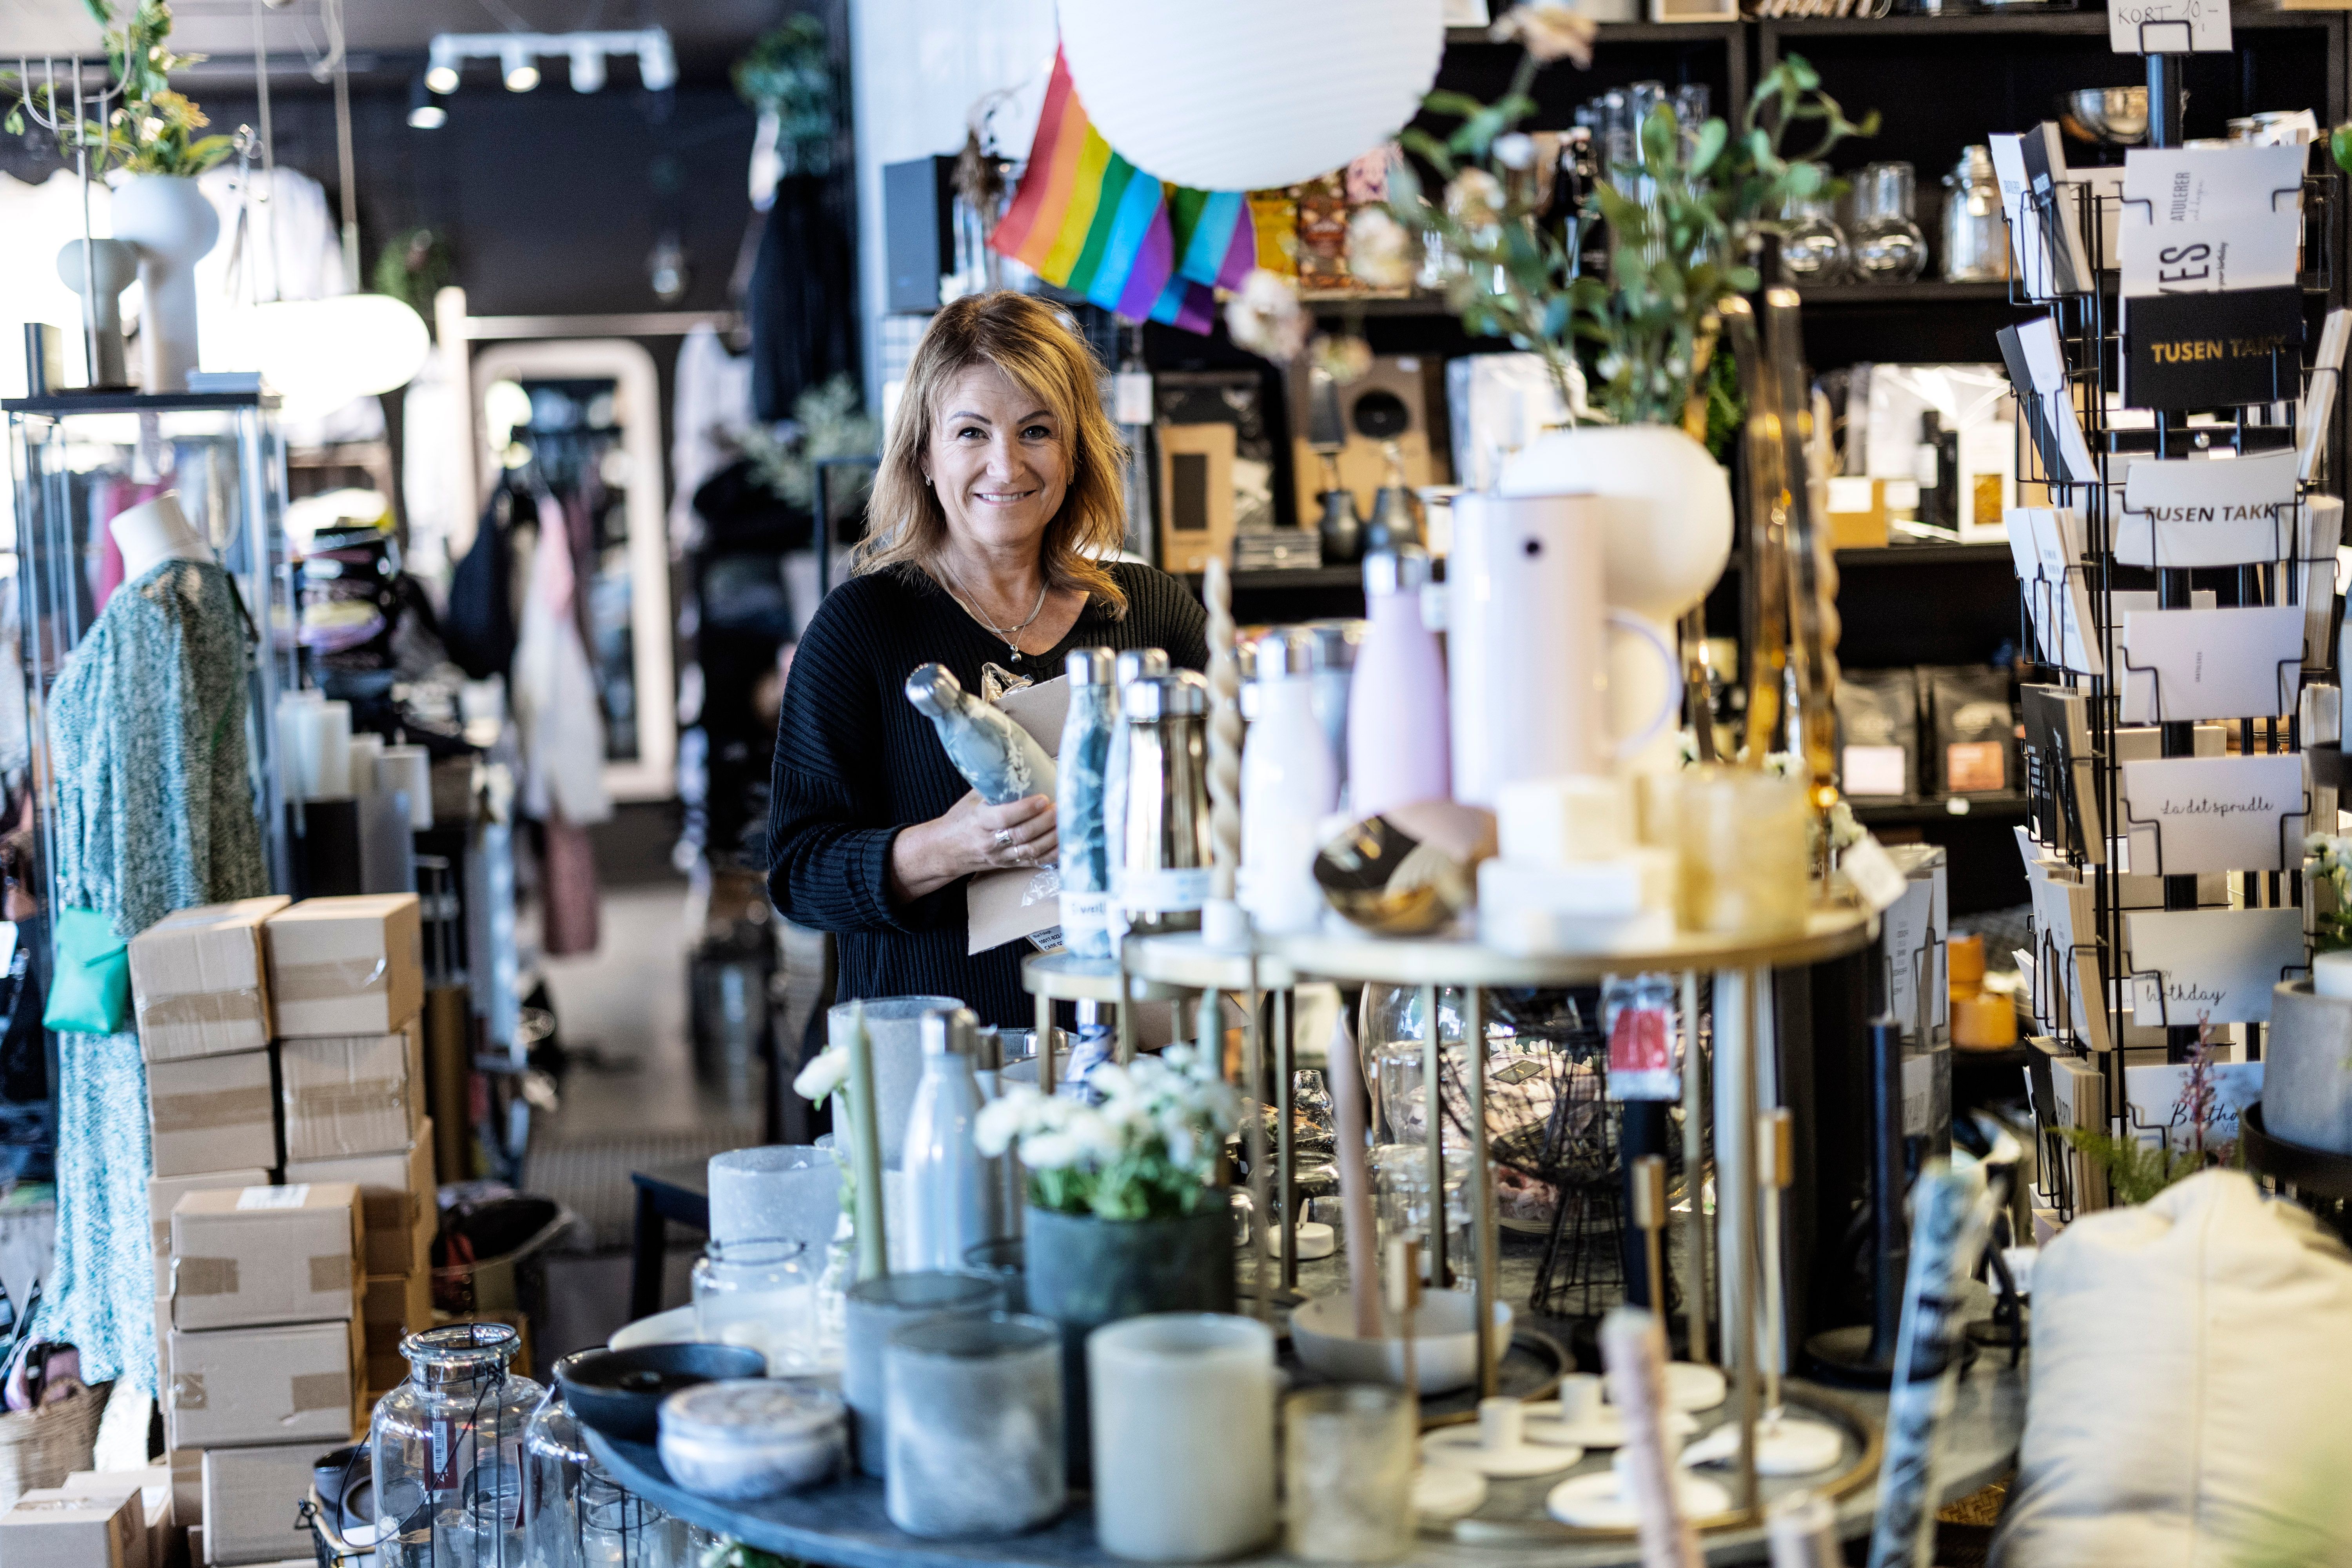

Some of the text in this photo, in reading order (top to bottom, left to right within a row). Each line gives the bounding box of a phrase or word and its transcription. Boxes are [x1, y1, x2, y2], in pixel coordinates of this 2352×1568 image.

[2118, 5, 2172, 24] KORT
[2158, 243, 2211, 293] ES
[2151, 340, 2223, 364] TUSEN
[2143, 503, 2275, 522] TUSEN TAKK
